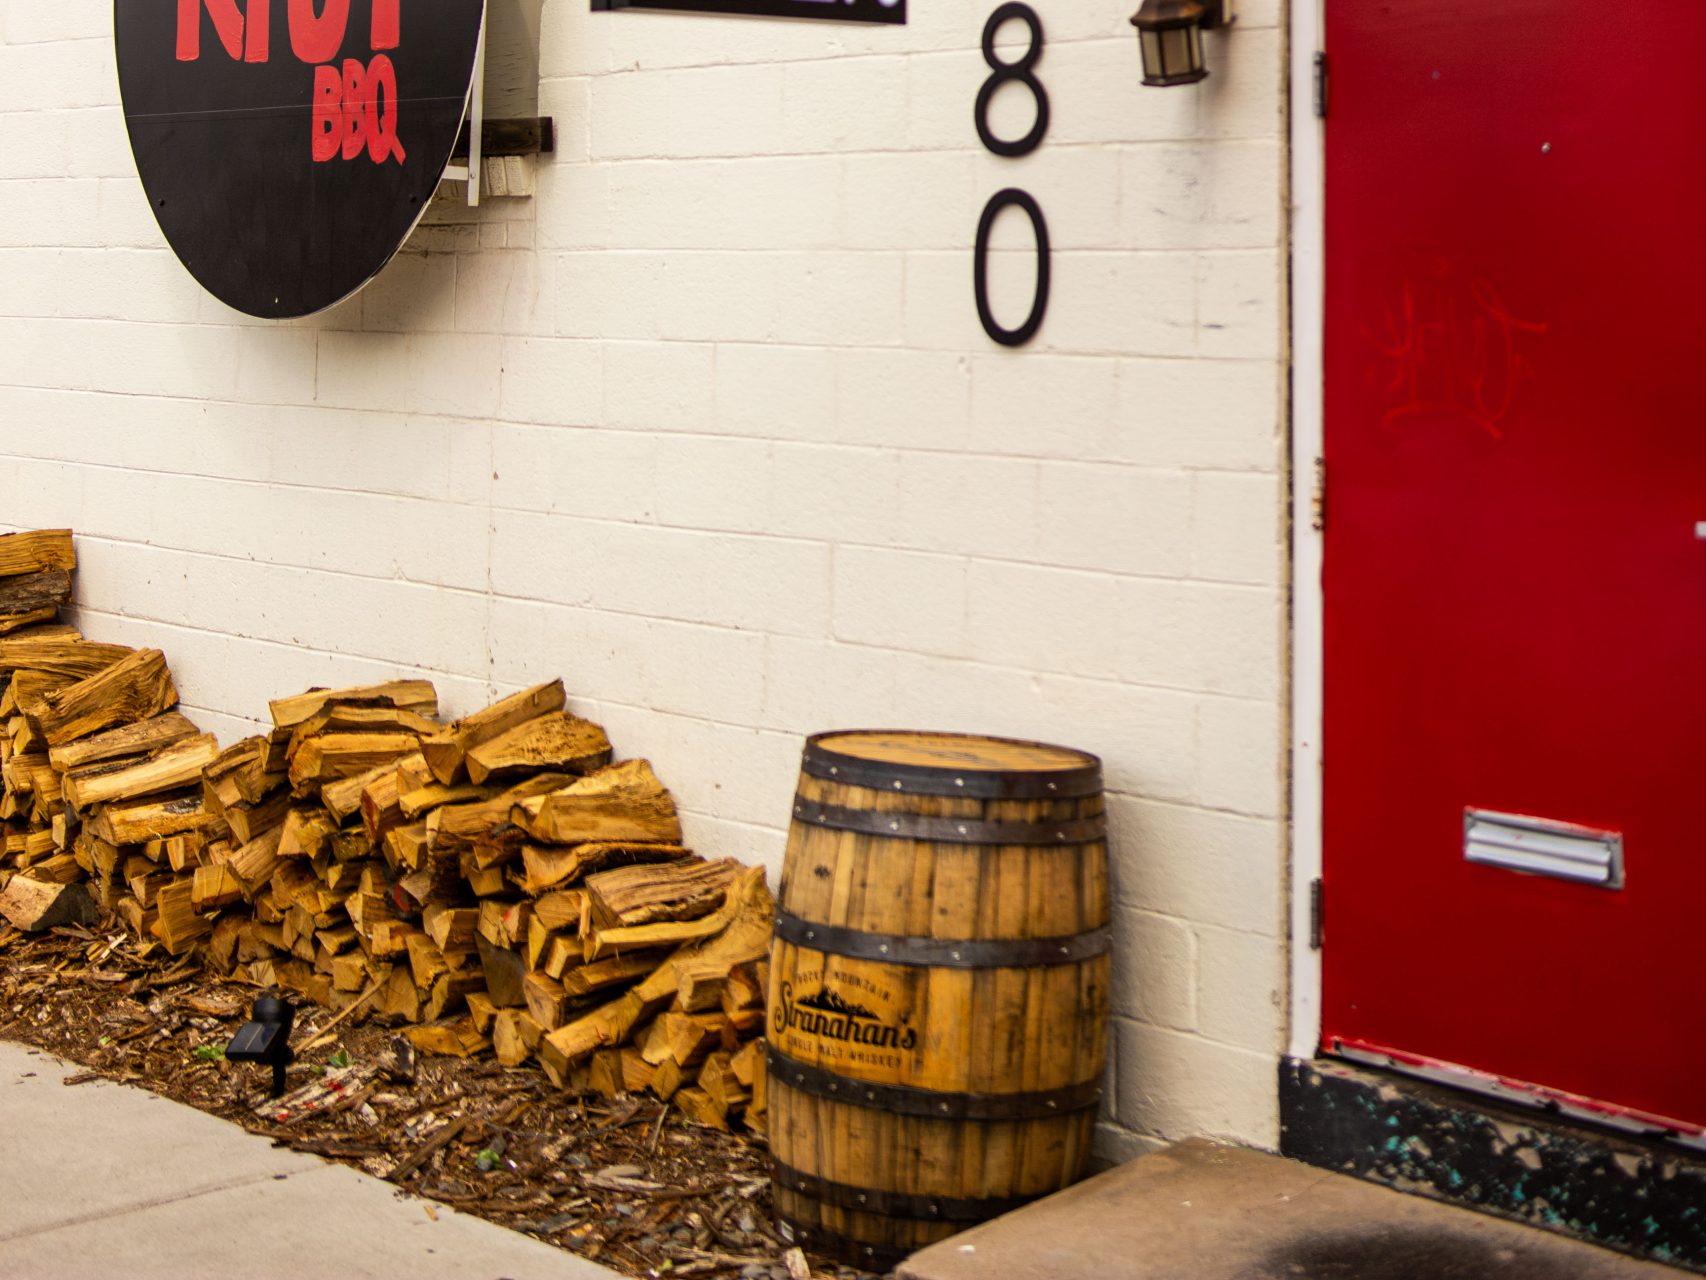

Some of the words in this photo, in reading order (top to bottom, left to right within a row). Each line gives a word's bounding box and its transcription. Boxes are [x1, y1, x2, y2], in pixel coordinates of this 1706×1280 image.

[312, 53, 405, 166] BBQ
[775, 980, 918, 1051] Stranahan's
[849, 1050, 902, 1069] WHISKEY
